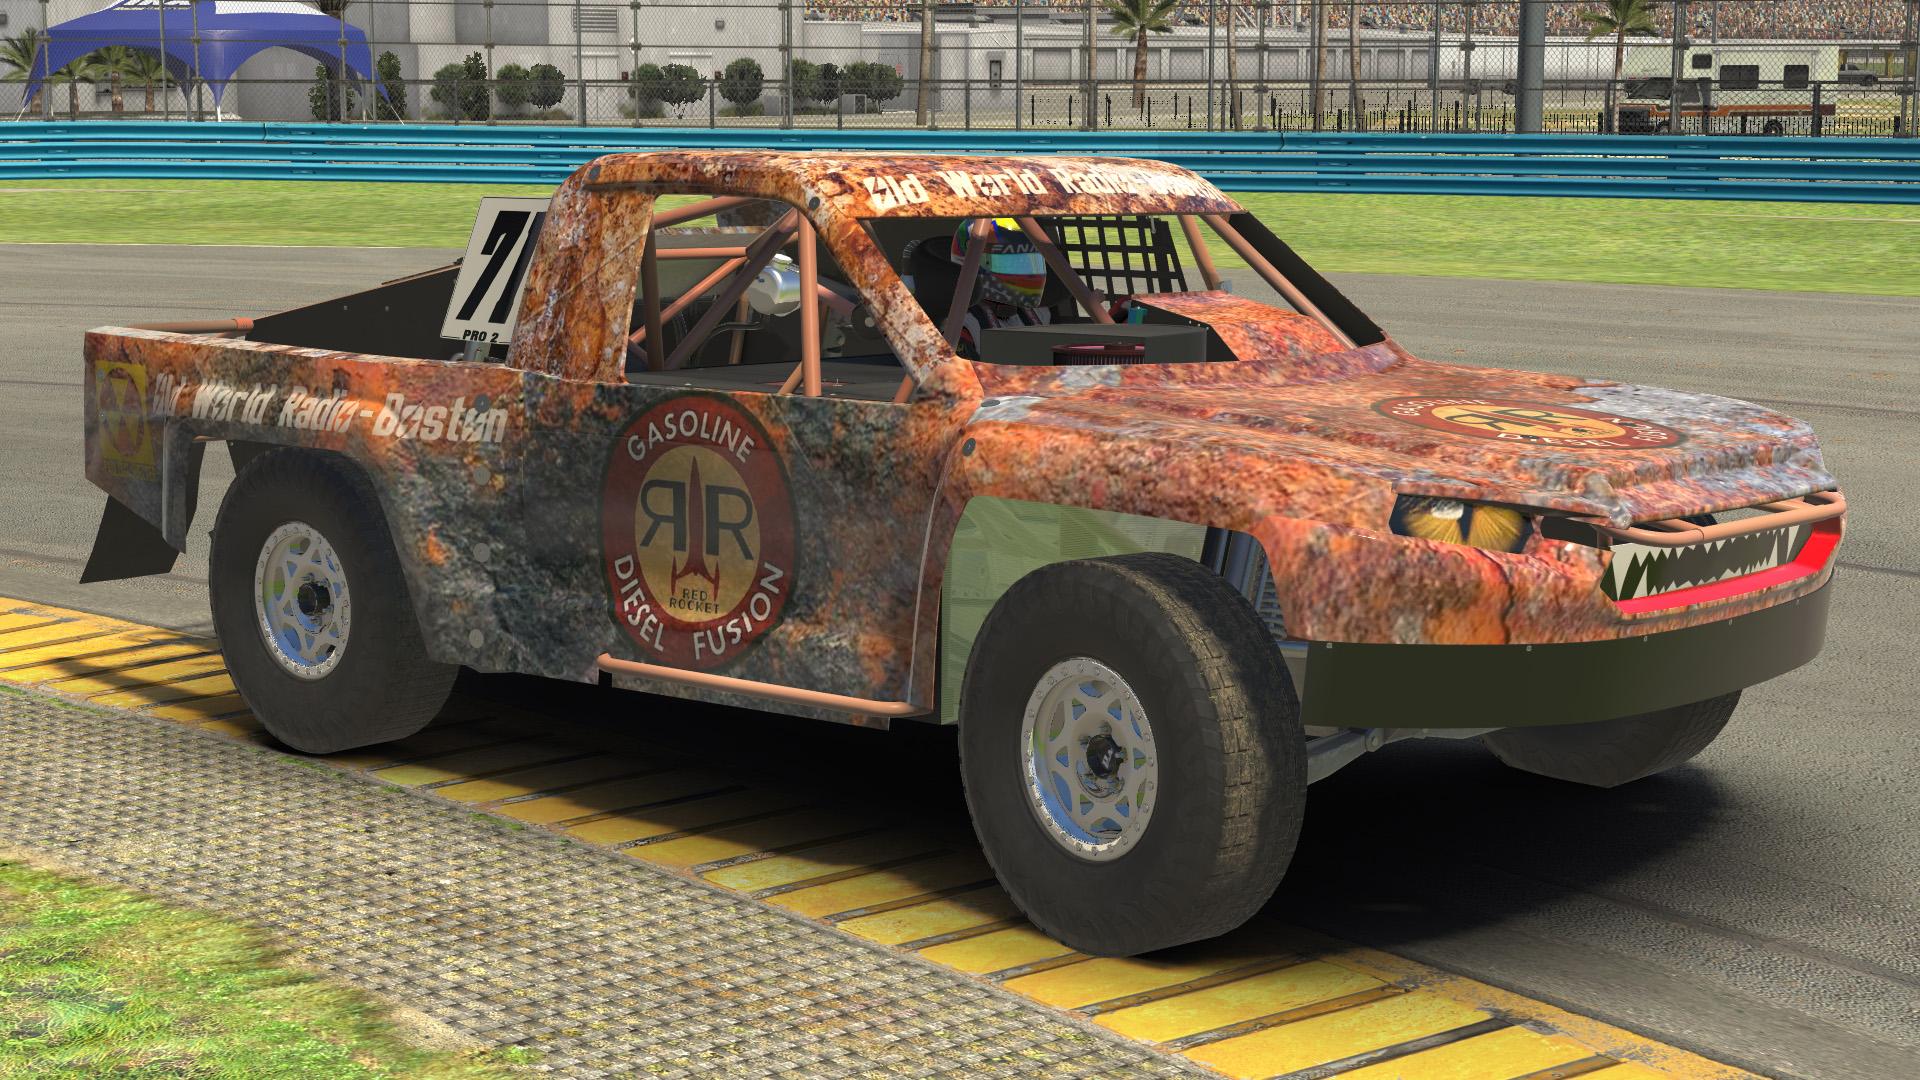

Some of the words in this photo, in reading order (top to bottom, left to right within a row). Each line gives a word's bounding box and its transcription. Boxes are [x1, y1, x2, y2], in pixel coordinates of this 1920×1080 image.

[938, 169, 1048, 197] World
[462, 329, 488, 342] PRO
[489, 332, 500, 343] 2
[192, 377, 278, 424] World
[627, 410, 755, 463] GASOLINE
[614, 554, 665, 652] DIESEL
[669, 597, 720, 614] ROCKET
[682, 588, 708, 600] RED
[693, 562, 784, 660] FUSION
